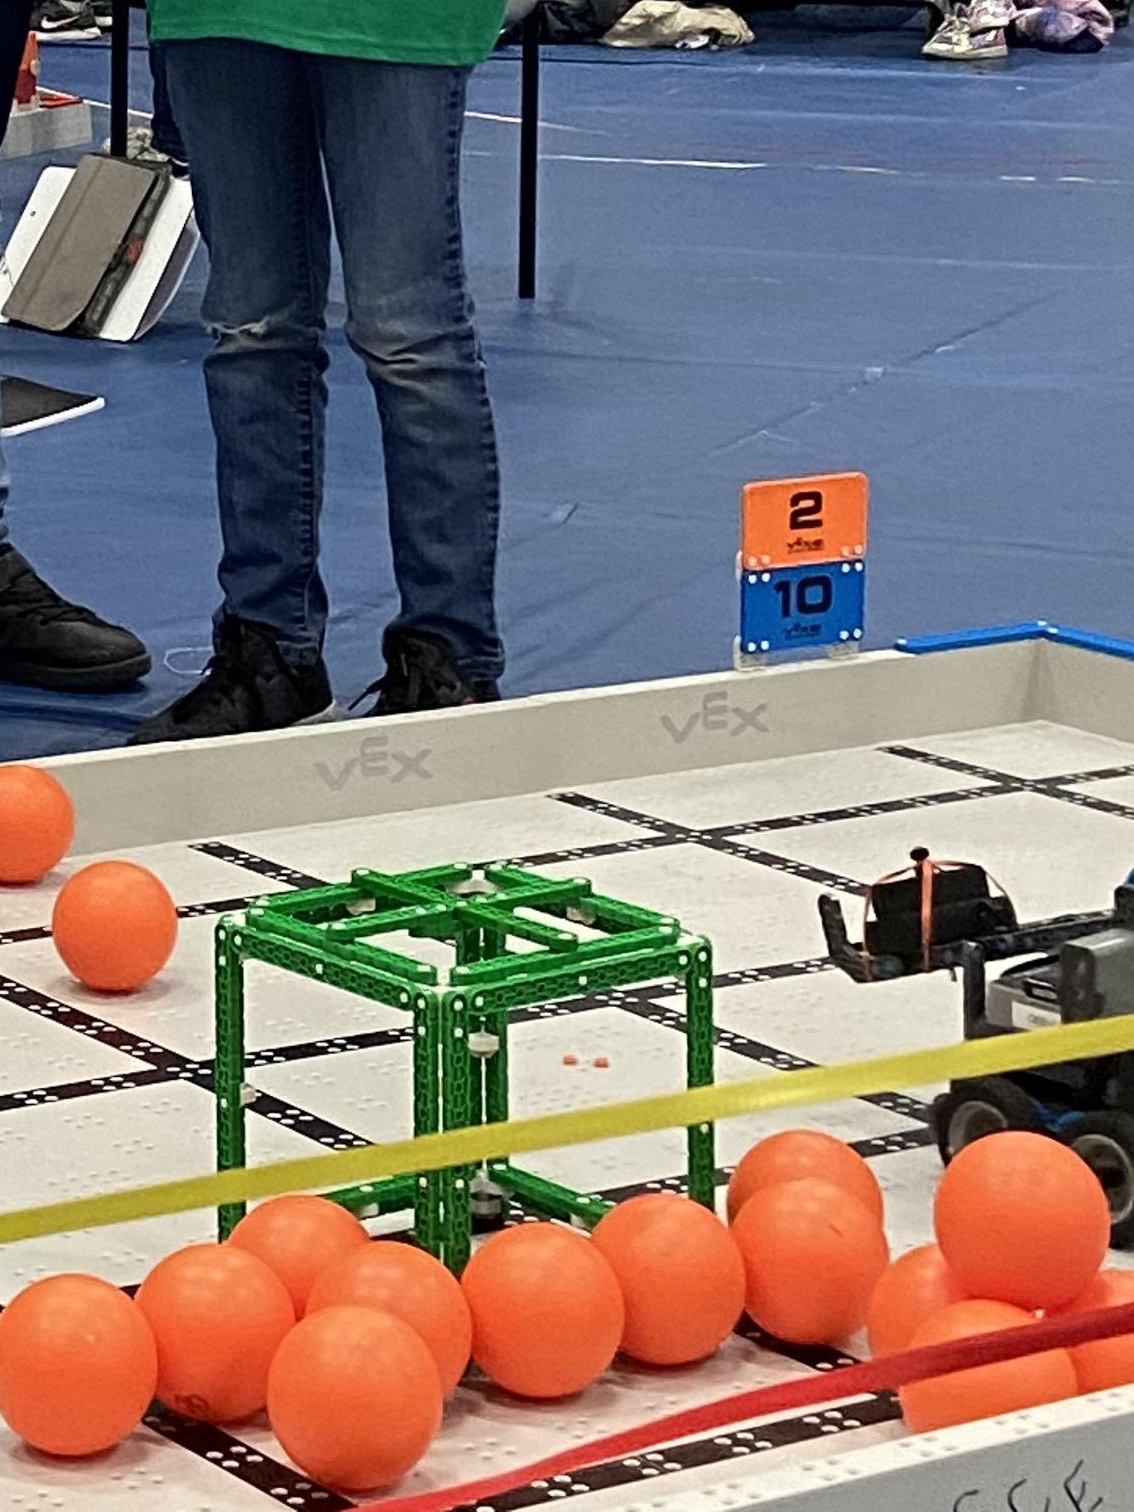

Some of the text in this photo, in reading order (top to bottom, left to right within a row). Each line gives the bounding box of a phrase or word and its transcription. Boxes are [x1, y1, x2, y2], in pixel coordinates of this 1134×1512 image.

[789, 490, 823, 530] 2
[774, 575, 833, 618] 10
[659, 690, 771, 744] VEX
[312, 736, 435, 790] VEX
